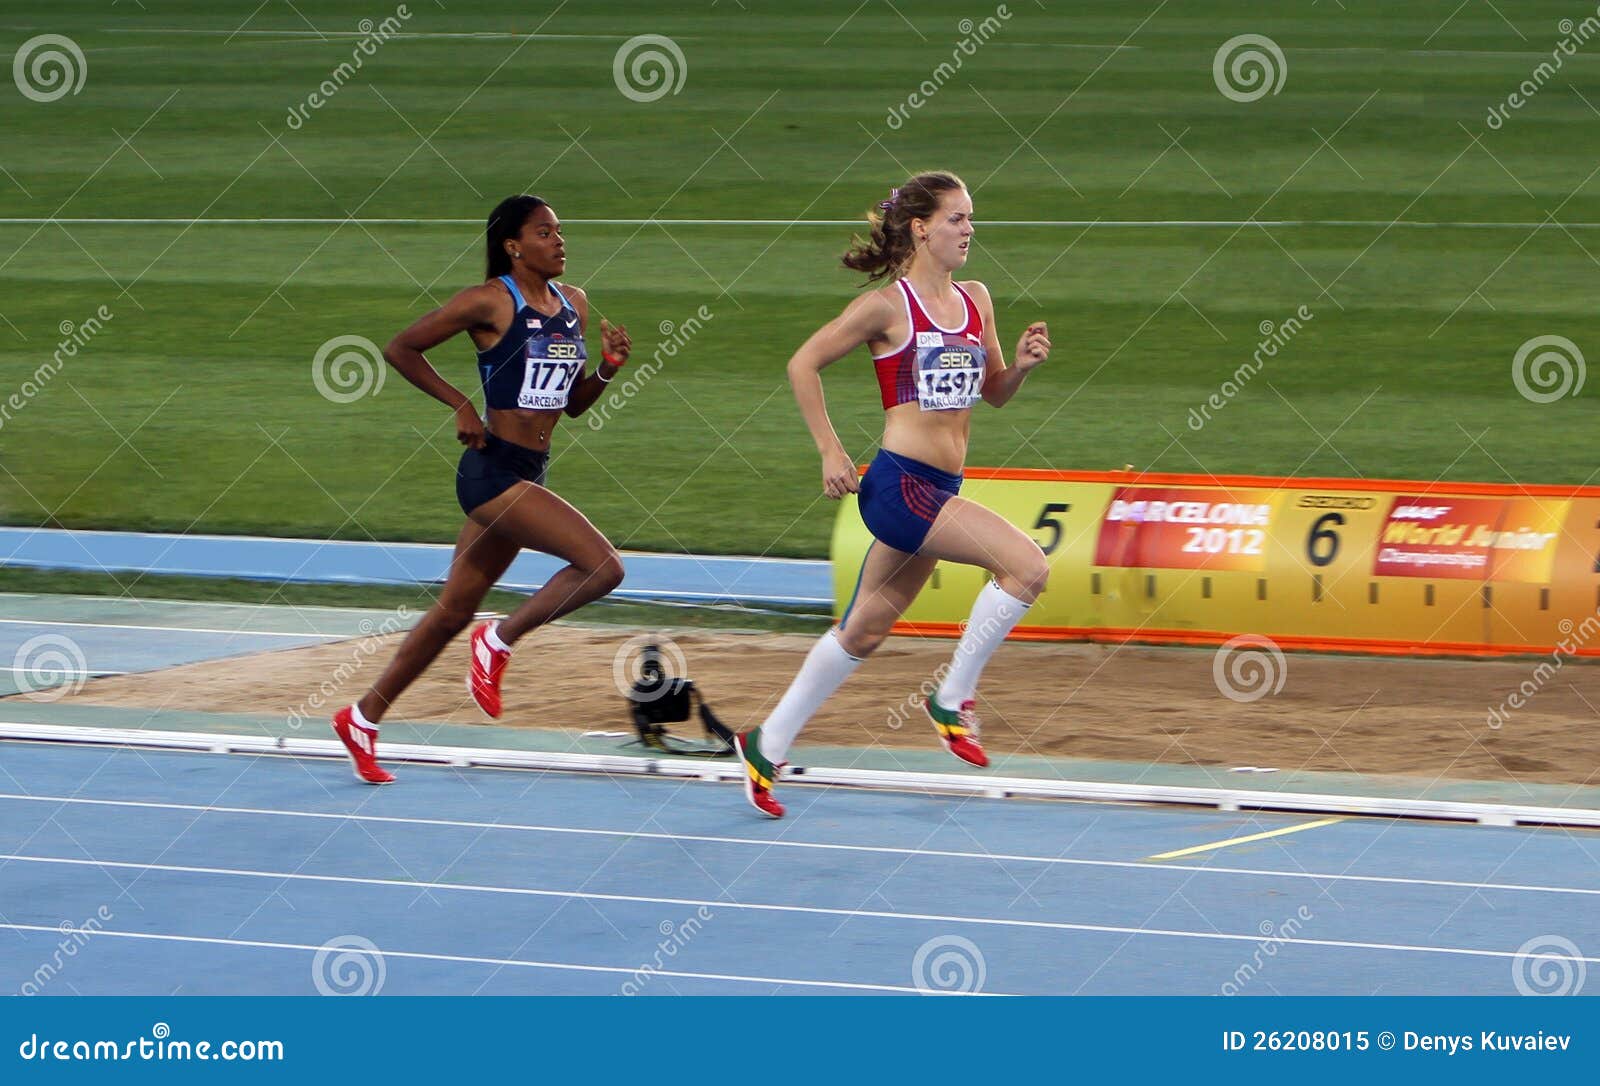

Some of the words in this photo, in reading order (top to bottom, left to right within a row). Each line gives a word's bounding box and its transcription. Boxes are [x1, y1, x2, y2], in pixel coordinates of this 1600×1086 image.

[1107, 500, 1271, 525] BARCELONA
[1032, 504, 1071, 555] 5
[1182, 527, 1264, 554] 2012
[1307, 512, 1346, 566] 6
[1382, 522, 1468, 545] World
[1463, 525, 1557, 549] Junior
